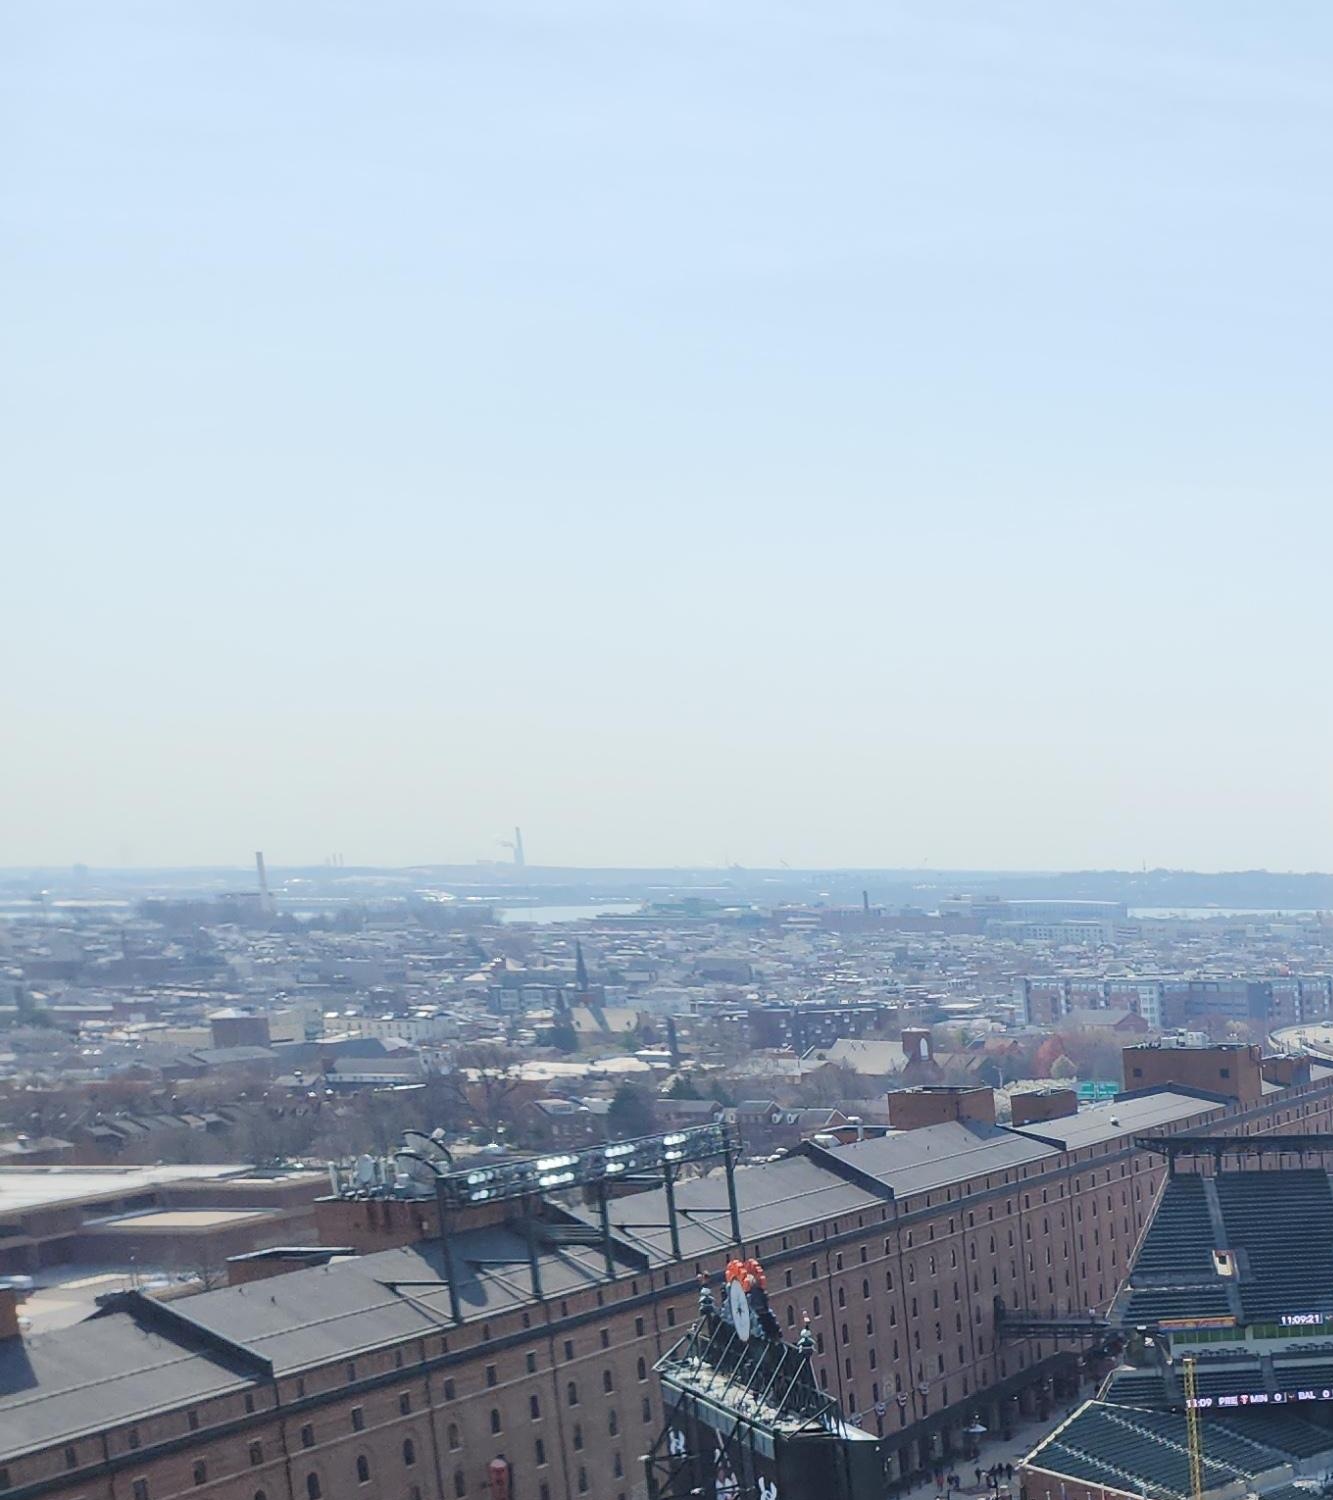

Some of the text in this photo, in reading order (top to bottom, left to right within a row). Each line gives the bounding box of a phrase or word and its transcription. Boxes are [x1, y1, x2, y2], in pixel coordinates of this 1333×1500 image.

[1280, 1314, 1321, 1326] 11:09:21
[1250, 1394, 1268, 1404] MIN
[1298, 1390, 1316, 1400] BAL
